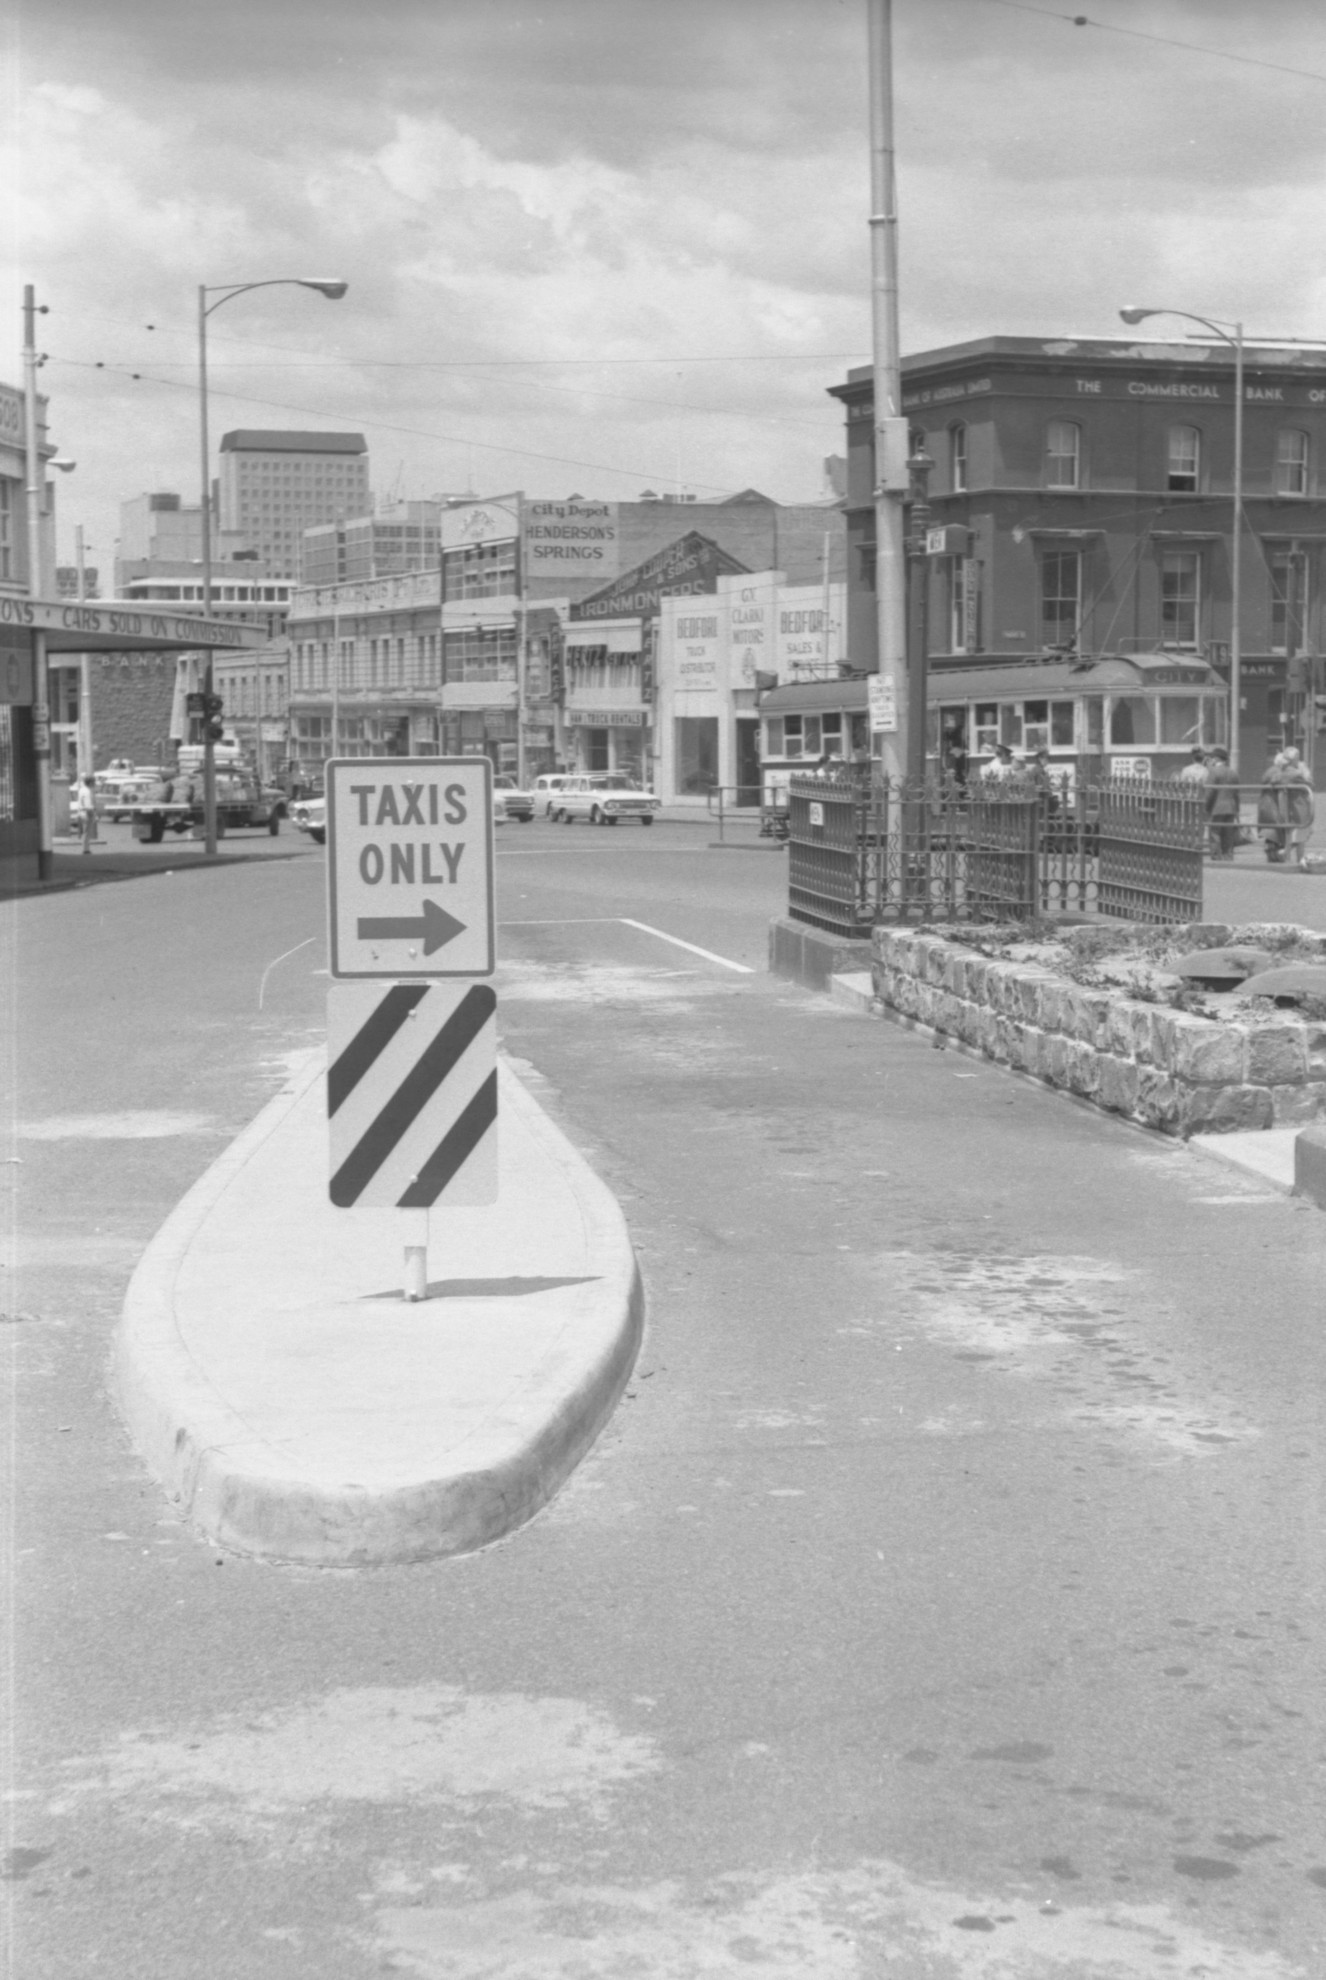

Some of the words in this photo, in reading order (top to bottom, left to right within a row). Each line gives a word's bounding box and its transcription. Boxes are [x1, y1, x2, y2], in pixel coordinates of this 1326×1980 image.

[1076, 379, 1102, 393] THE
[1128, 382, 1221, 399] COMMERCIAL
[1245, 387, 1284, 401] BANK
[532, 504, 565, 519] City
[568, 504, 609, 519] Depot
[533, 545, 604, 560] SPRINGS
[667, 555, 698, 579] SONS
[62, 606, 101, 632] CARS
[109, 614, 142, 635] SOLD
[151, 618, 168, 638] ON
[175, 620, 243, 645] COMMISSION
[787, 642, 812, 654] SALES
[101, 656, 165, 667] BANK
[1154, 671, 1198, 684] CITY
[1240, 663, 1276, 677] BANK
[610, 713, 641, 725] RENTALS
[349, 783, 468, 826] TAXIS
[359, 841, 466, 885] ONLY
